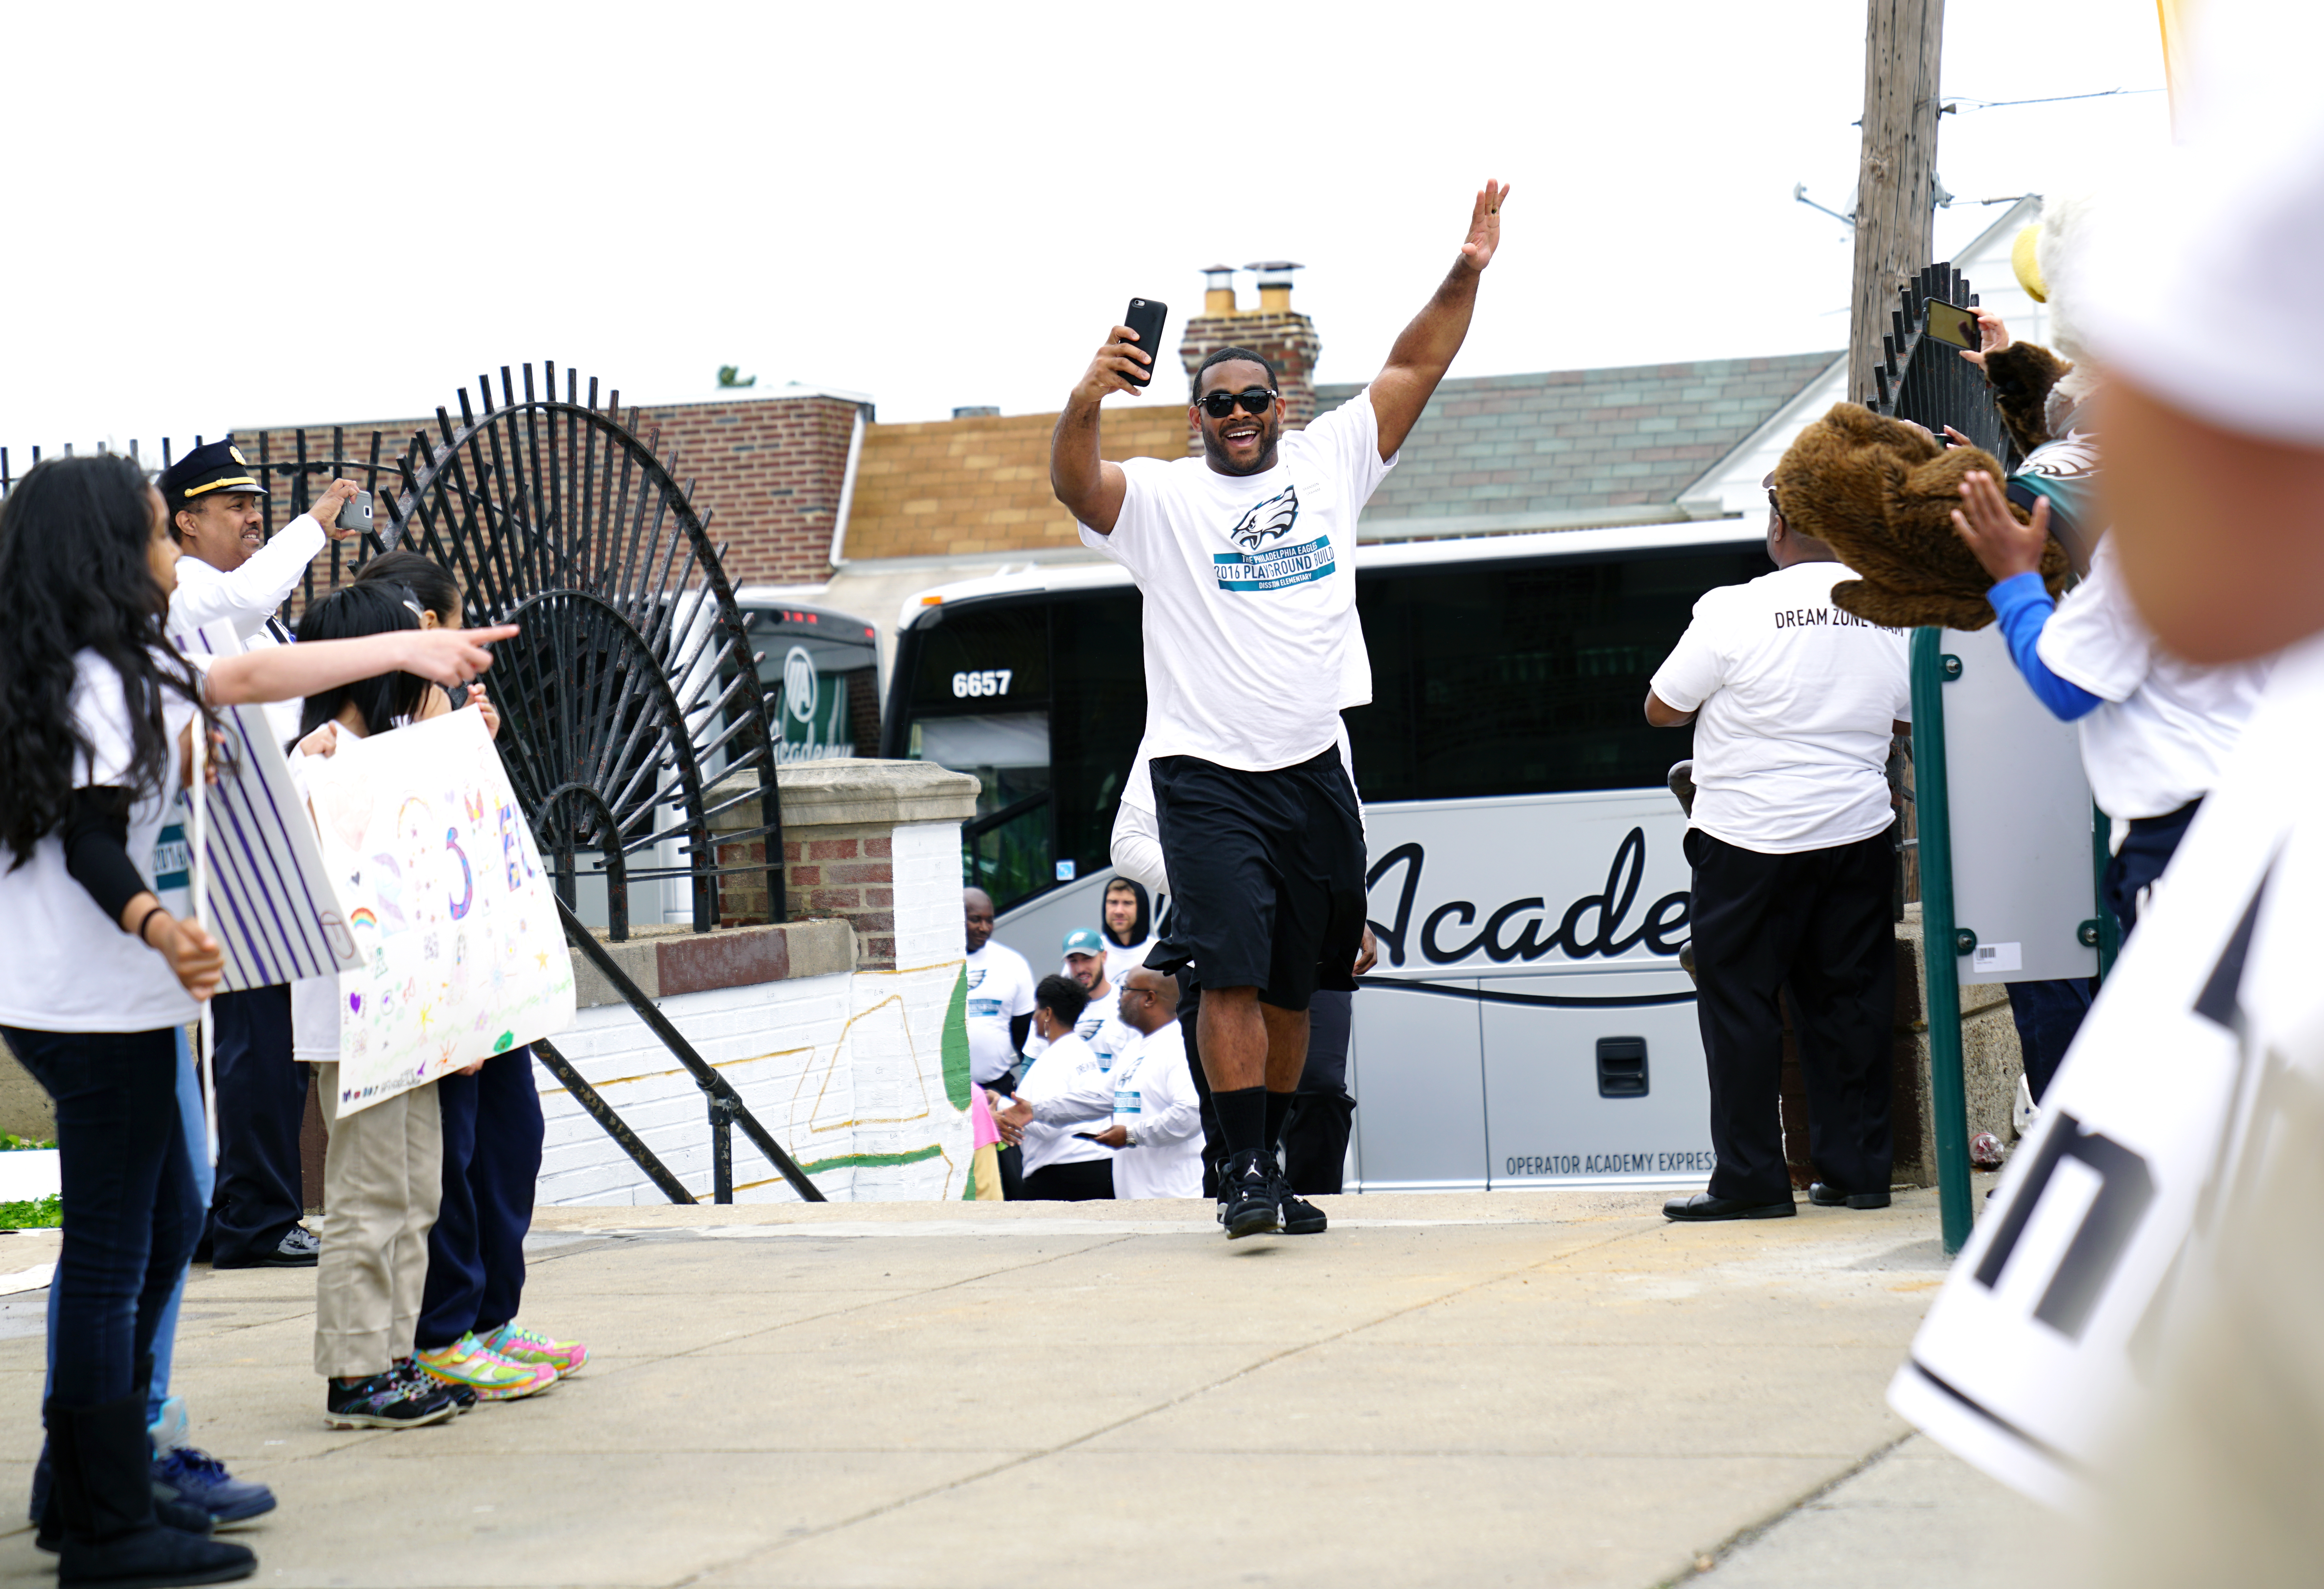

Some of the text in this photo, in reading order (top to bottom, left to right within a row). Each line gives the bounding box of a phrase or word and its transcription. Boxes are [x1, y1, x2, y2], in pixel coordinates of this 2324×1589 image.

[1302, 482, 1319, 491] BRANDON
[1214, 546, 1334, 579] 2016 PLAYGROUND BUILD
[1242, 541, 1317, 564] THE PHILADELPHIA EAGLES
[1259, 573, 1312, 589] DISSTON ELEMENTARY
[1775, 608, 1827, 629] DREAM
[952, 669, 1012, 698] 6657
[1506, 1155, 1580, 1175] OPERATOR
[1585, 1153, 1654, 1174] ACADEMY
